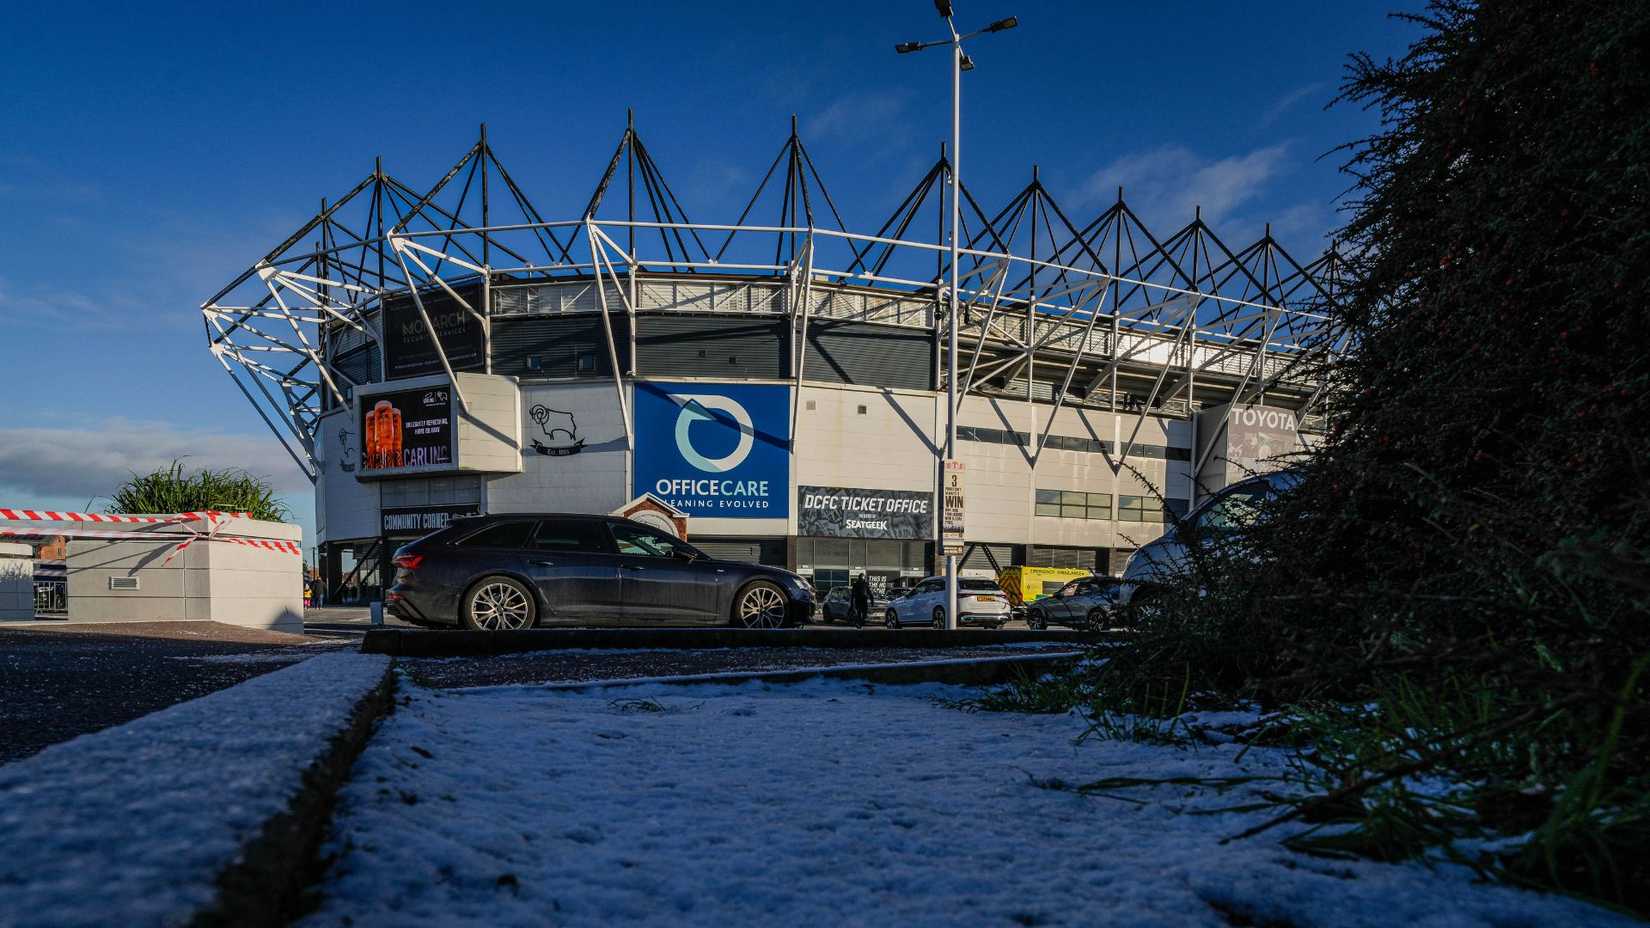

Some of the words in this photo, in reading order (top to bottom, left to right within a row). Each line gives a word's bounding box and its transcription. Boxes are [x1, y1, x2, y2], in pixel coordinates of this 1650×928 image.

[1231, 408, 1295, 431] TOYOTA
[656, 479, 769, 496] OFFICECARE
[951, 474, 958, 487] 3
[719, 500, 769, 509] EVOLVED
[804, 494, 839, 509] DCFC
[840, 496, 885, 512] TICKET
[886, 498, 929, 514] OFFICE
[945, 496, 964, 508] WIN
[384, 513, 421, 530] COMMUNITY
[846, 519, 888, 530] SEATGEEK
